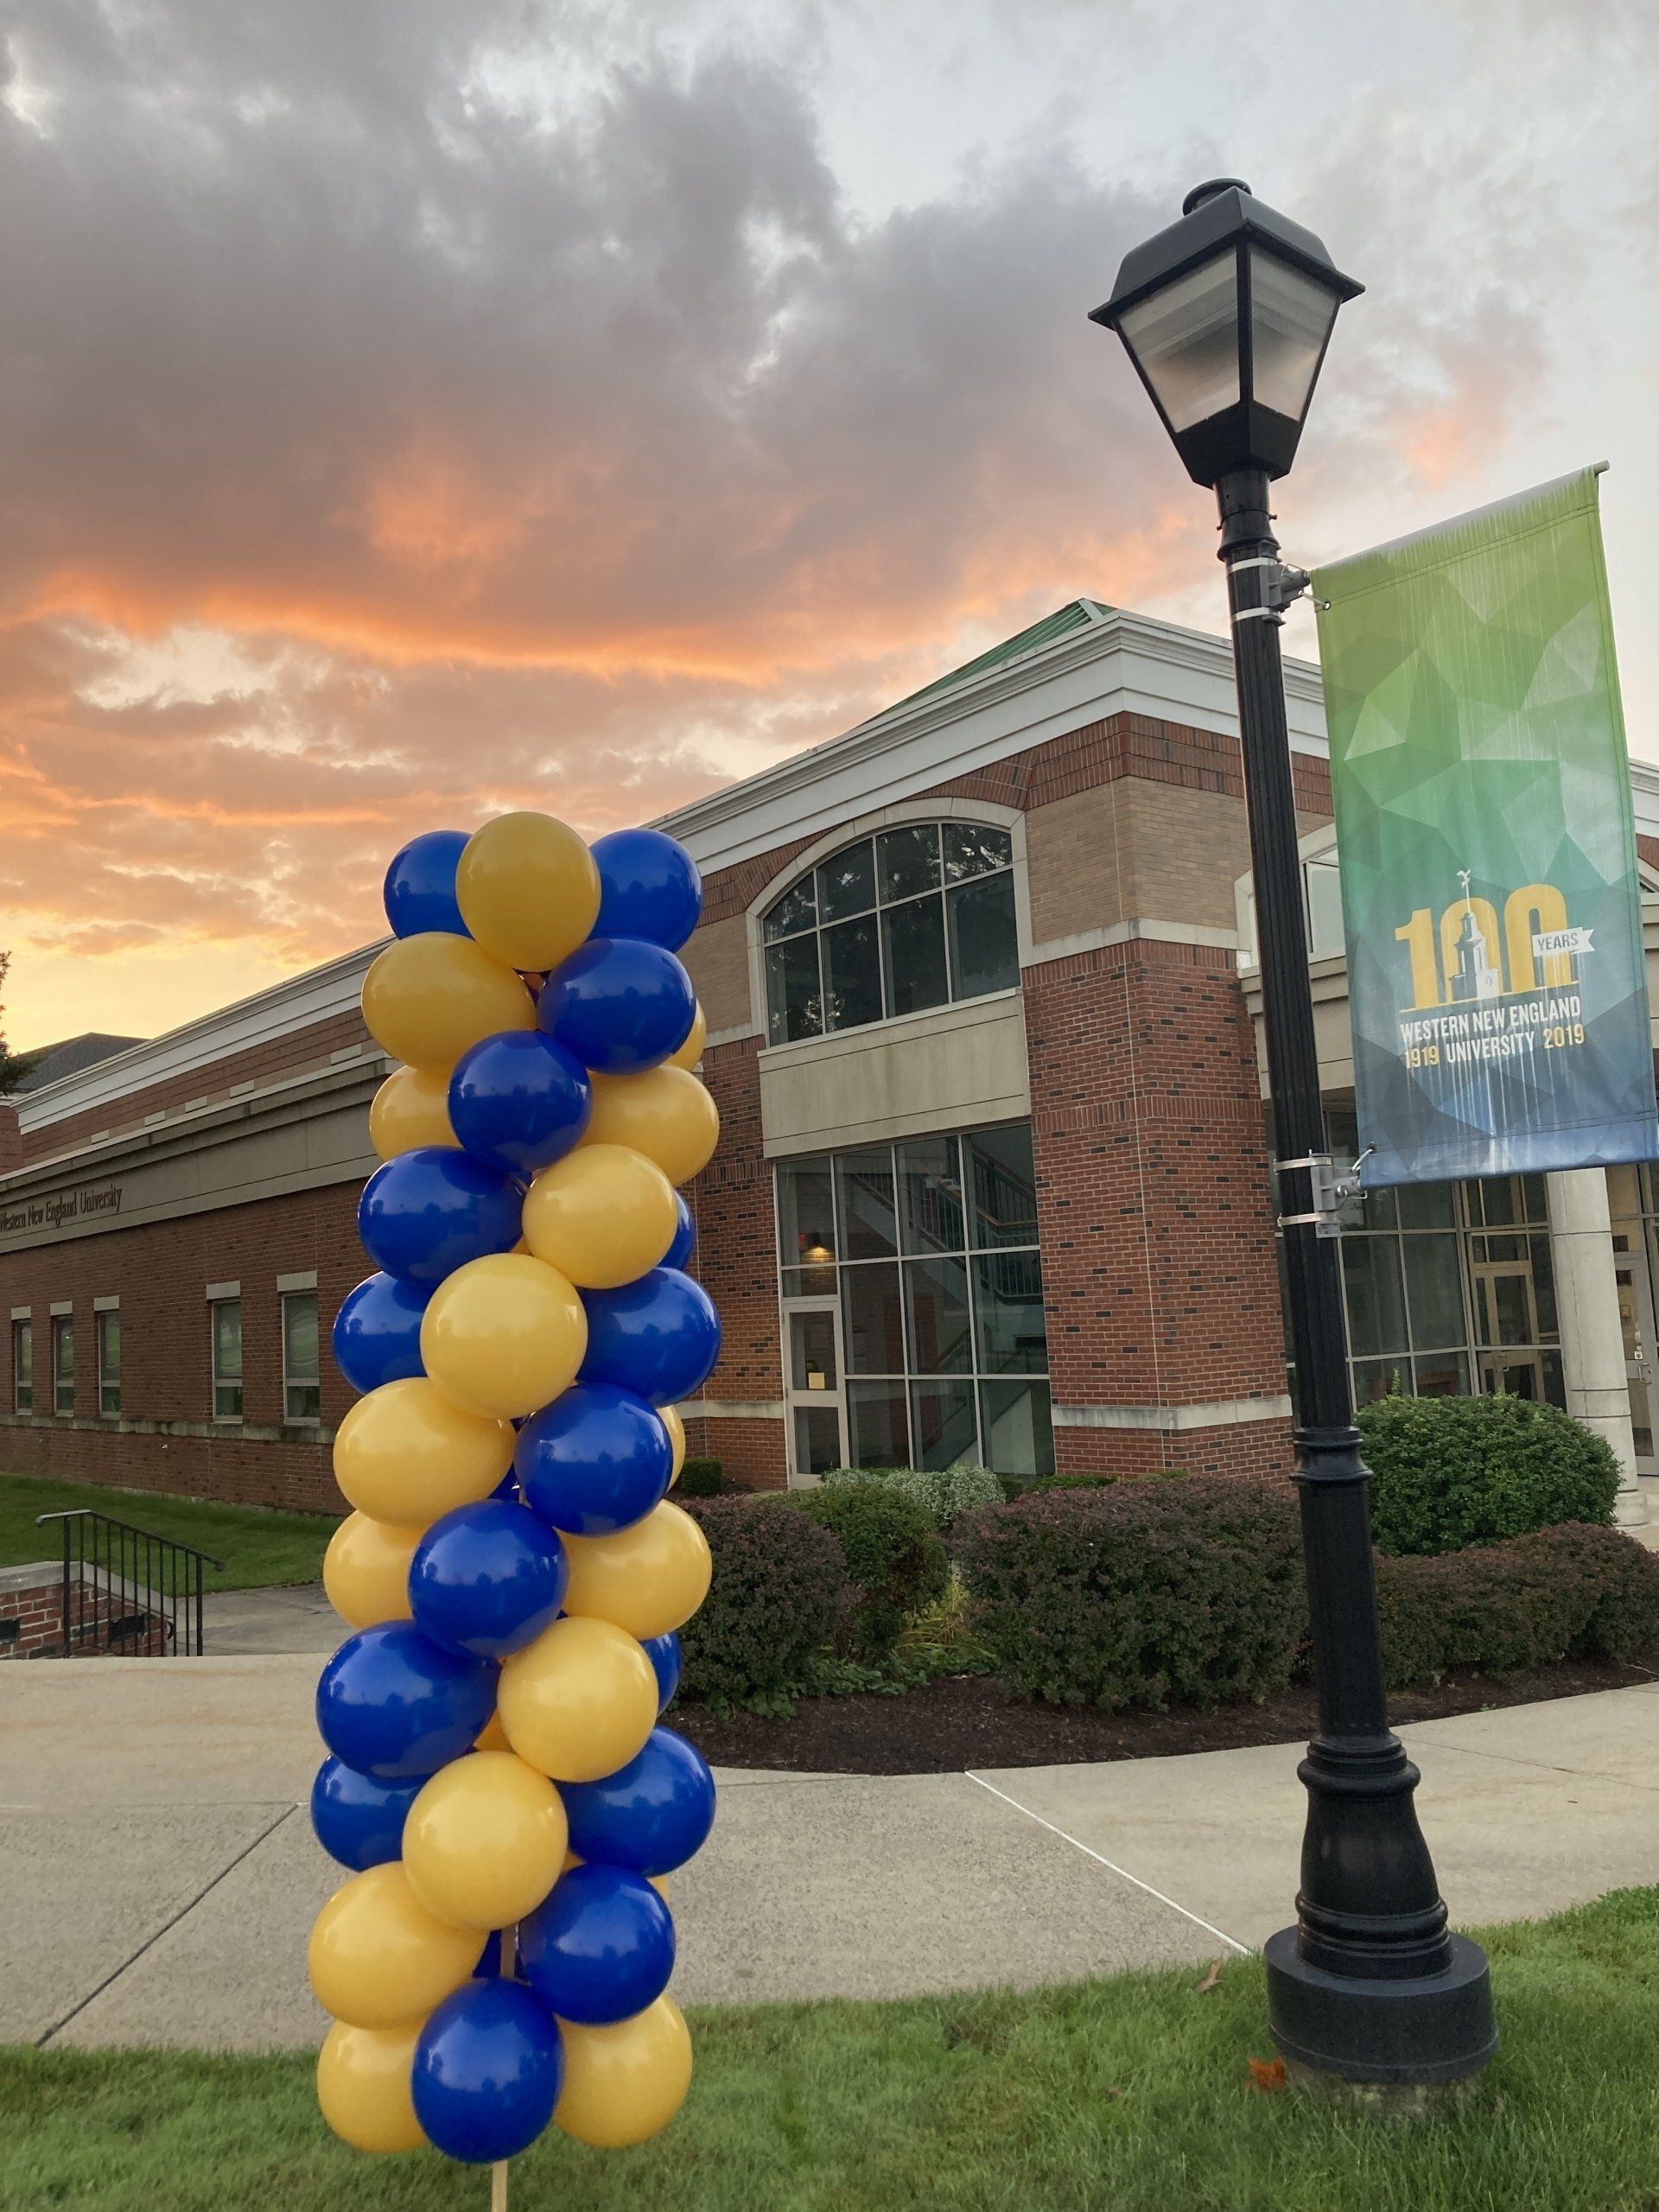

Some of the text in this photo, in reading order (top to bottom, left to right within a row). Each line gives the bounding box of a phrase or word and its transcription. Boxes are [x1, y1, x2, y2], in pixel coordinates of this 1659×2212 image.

[1395, 883, 1572, 1009] 100
[1537, 932, 1578, 950] YEARS
[1401, 995, 1581, 1045] WESTERN NEW ENGLAND
[1404, 1023, 1585, 1069] 1919 UNIVERSITY 2019
[28, 1205, 44, 1227] New
[46, 1192, 77, 1227] England
[80, 1183, 122, 1213] University
